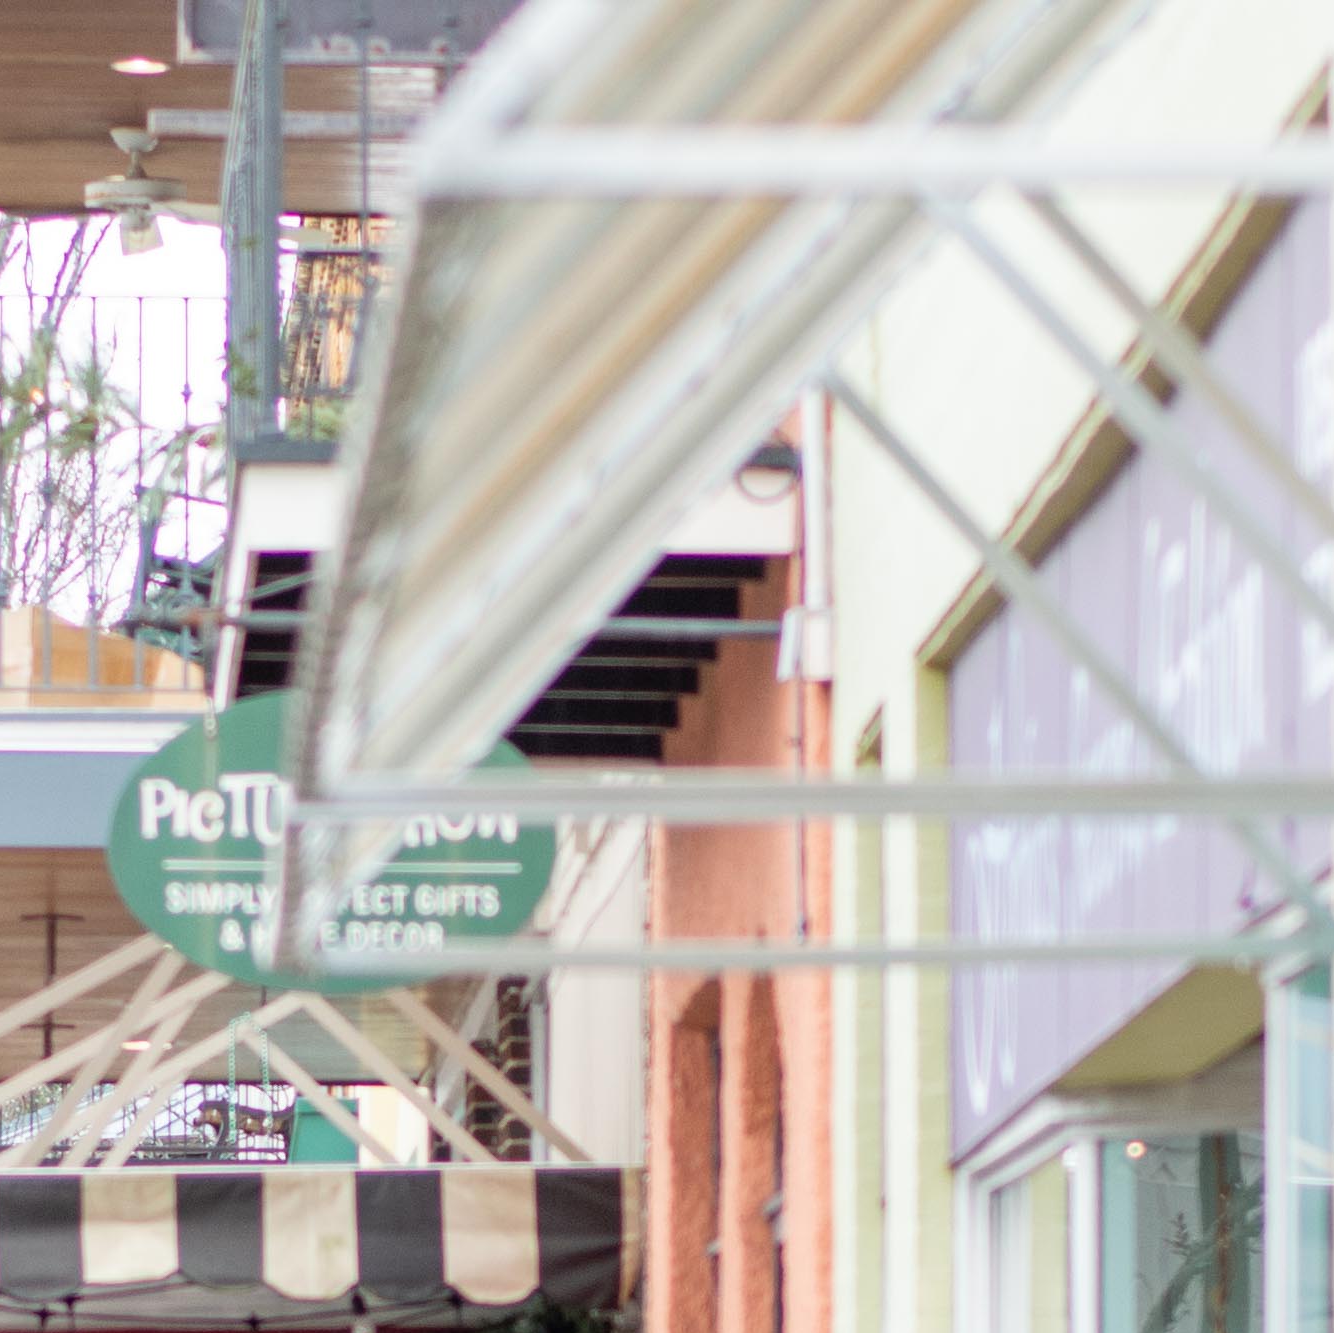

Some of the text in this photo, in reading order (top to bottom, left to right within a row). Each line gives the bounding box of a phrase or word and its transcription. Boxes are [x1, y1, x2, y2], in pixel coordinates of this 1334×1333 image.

[165, 881, 277, 915] SIMPLY
[414, 883, 501, 918] GIFTS
[219, 919, 246, 951] &
[345, 920, 446, 952] DECOR
